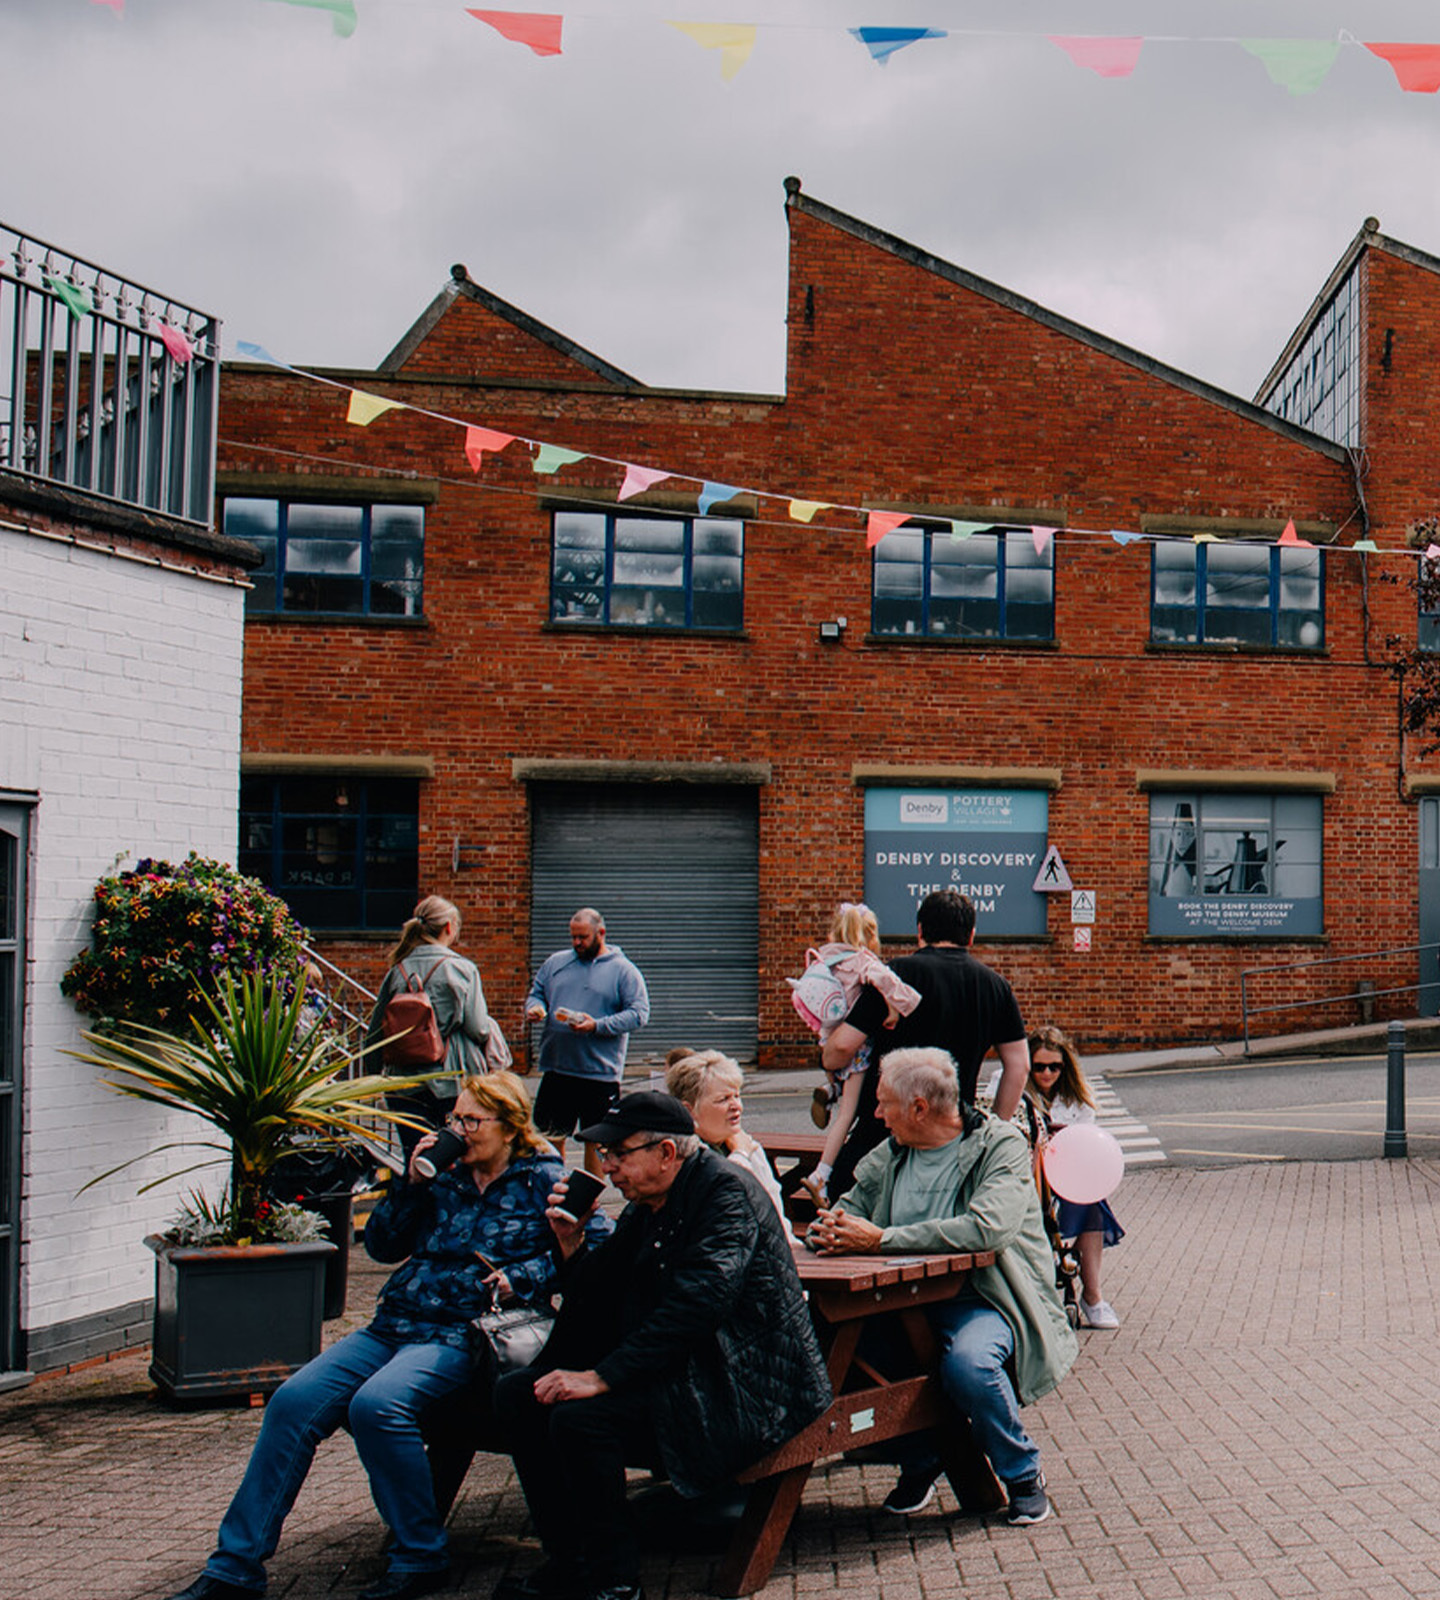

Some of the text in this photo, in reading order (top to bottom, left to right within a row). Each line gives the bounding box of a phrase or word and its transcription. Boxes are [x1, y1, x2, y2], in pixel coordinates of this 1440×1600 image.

[953, 796, 1013, 807] POTTERY
[906, 801, 944, 816] Denby
[953, 807, 997, 816] VILLAGE
[875, 852, 1037, 866] DENBY DISCOVERY
[951, 868, 961, 881] &
